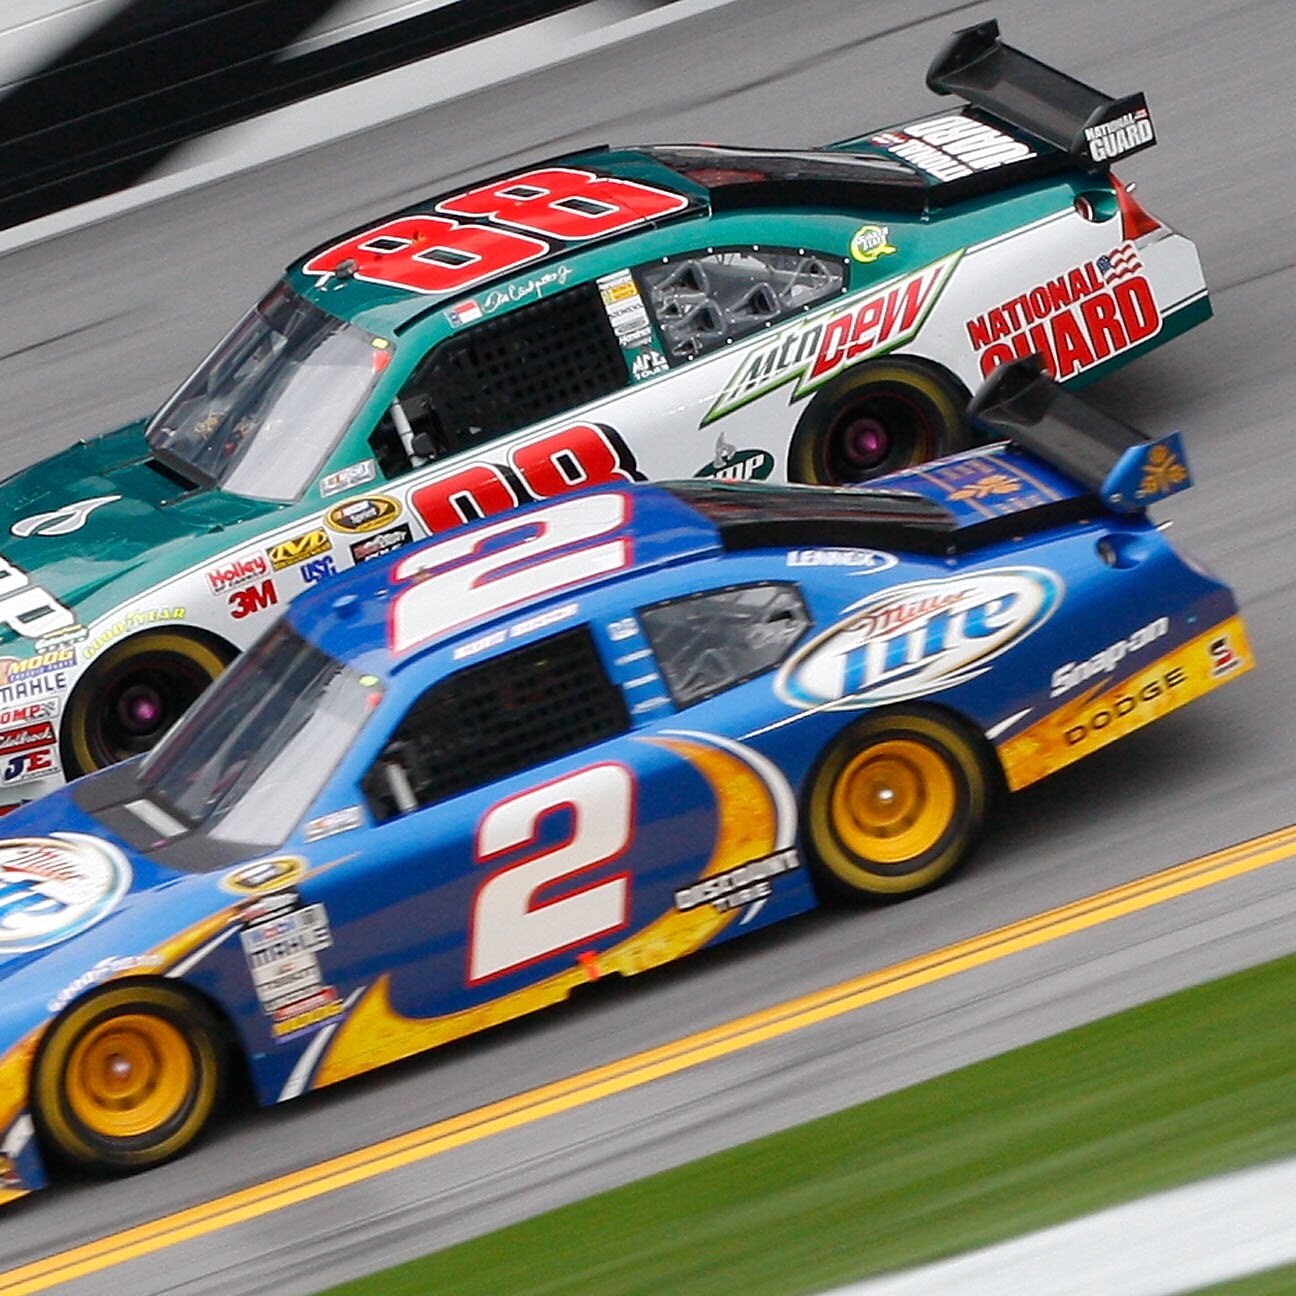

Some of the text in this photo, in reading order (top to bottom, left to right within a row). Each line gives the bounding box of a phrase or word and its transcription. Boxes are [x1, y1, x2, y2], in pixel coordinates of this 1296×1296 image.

[904, 116, 1038, 170] UARD
[1085, 112, 1135, 142] NATIONAL
[1088, 117, 1154, 163] GUARD
[304, 168, 689, 294] 88
[967, 262, 1105, 350] NATIONAL
[208, 556, 266, 587] Holley
[388, 492, 633, 656] 2
[229, 579, 278, 619] 3M
[10, 649, 75, 674] MOOG
[1064, 666, 1188, 746] DODGE
[5, 749, 52, 781] JE
[466, 761, 636, 988] 2
